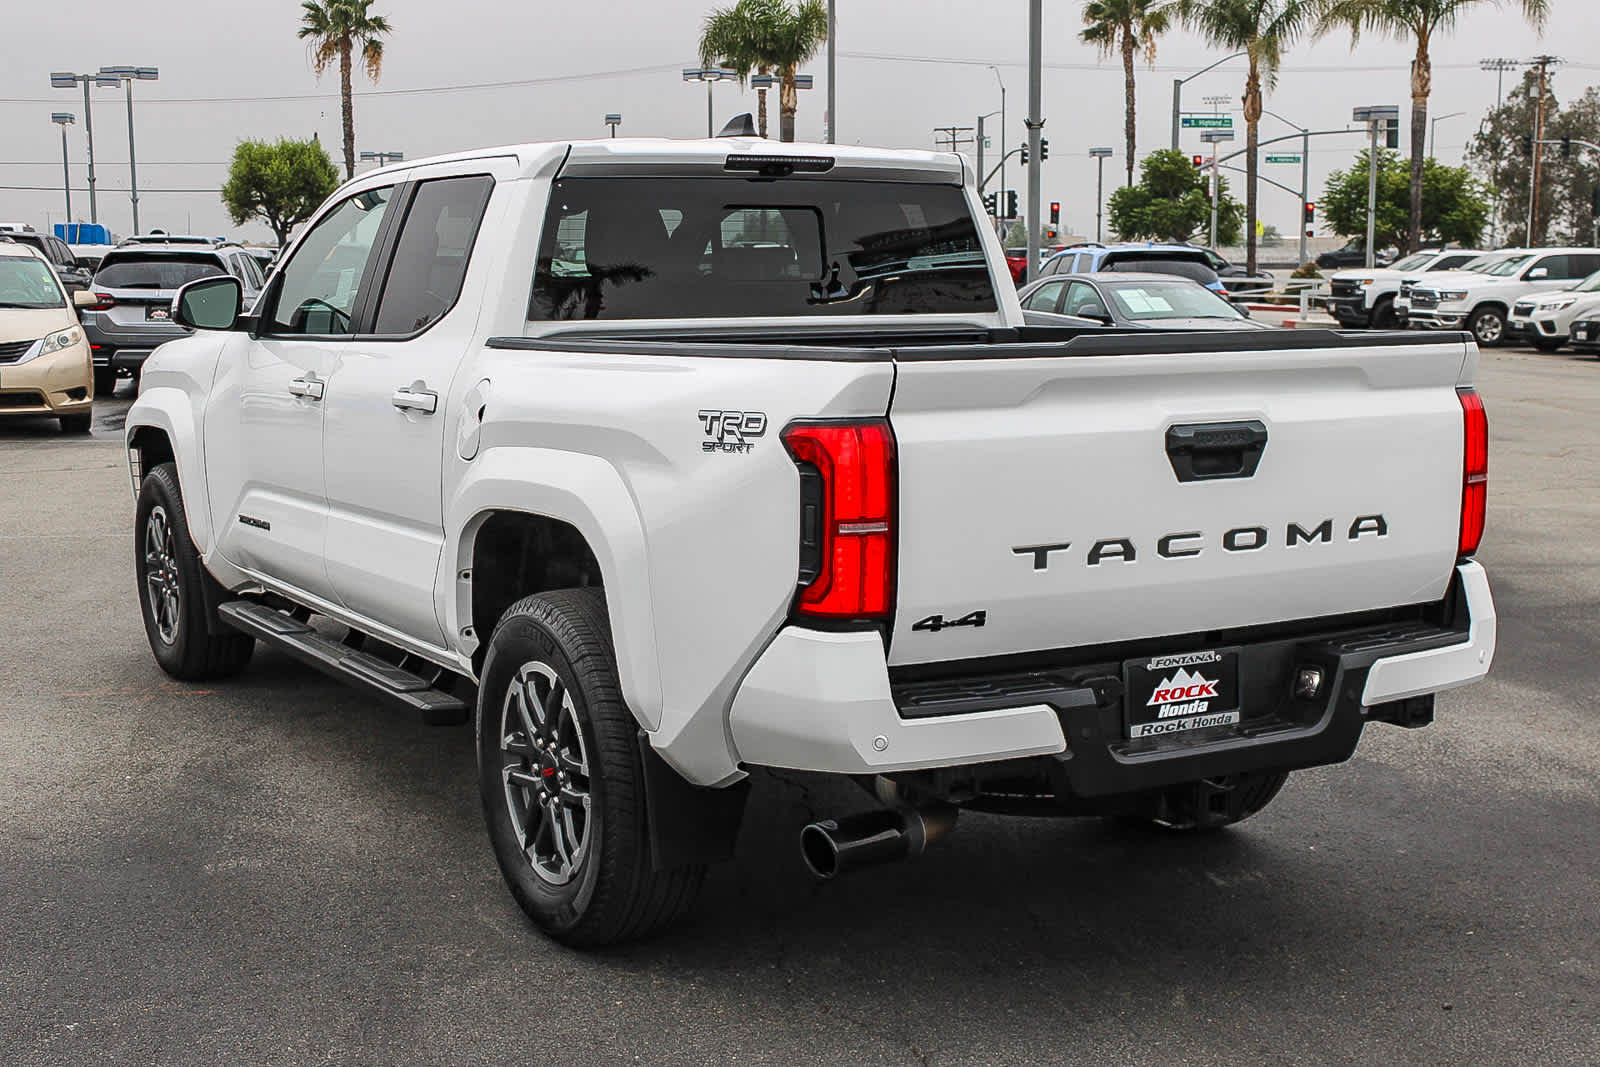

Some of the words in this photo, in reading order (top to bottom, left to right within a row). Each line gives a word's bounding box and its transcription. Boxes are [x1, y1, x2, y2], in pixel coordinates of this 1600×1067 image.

[698, 409, 768, 442] TRD
[702, 441, 754, 454] SPORT
[1012, 514, 1388, 570] TACOMA
[1154, 653, 1214, 668] FONTANA
[1153, 683, 1214, 703] ROCK
[1158, 700, 1208, 718] Honda
[1140, 721, 1187, 736] Rock
[1192, 714, 1232, 729] Honda
